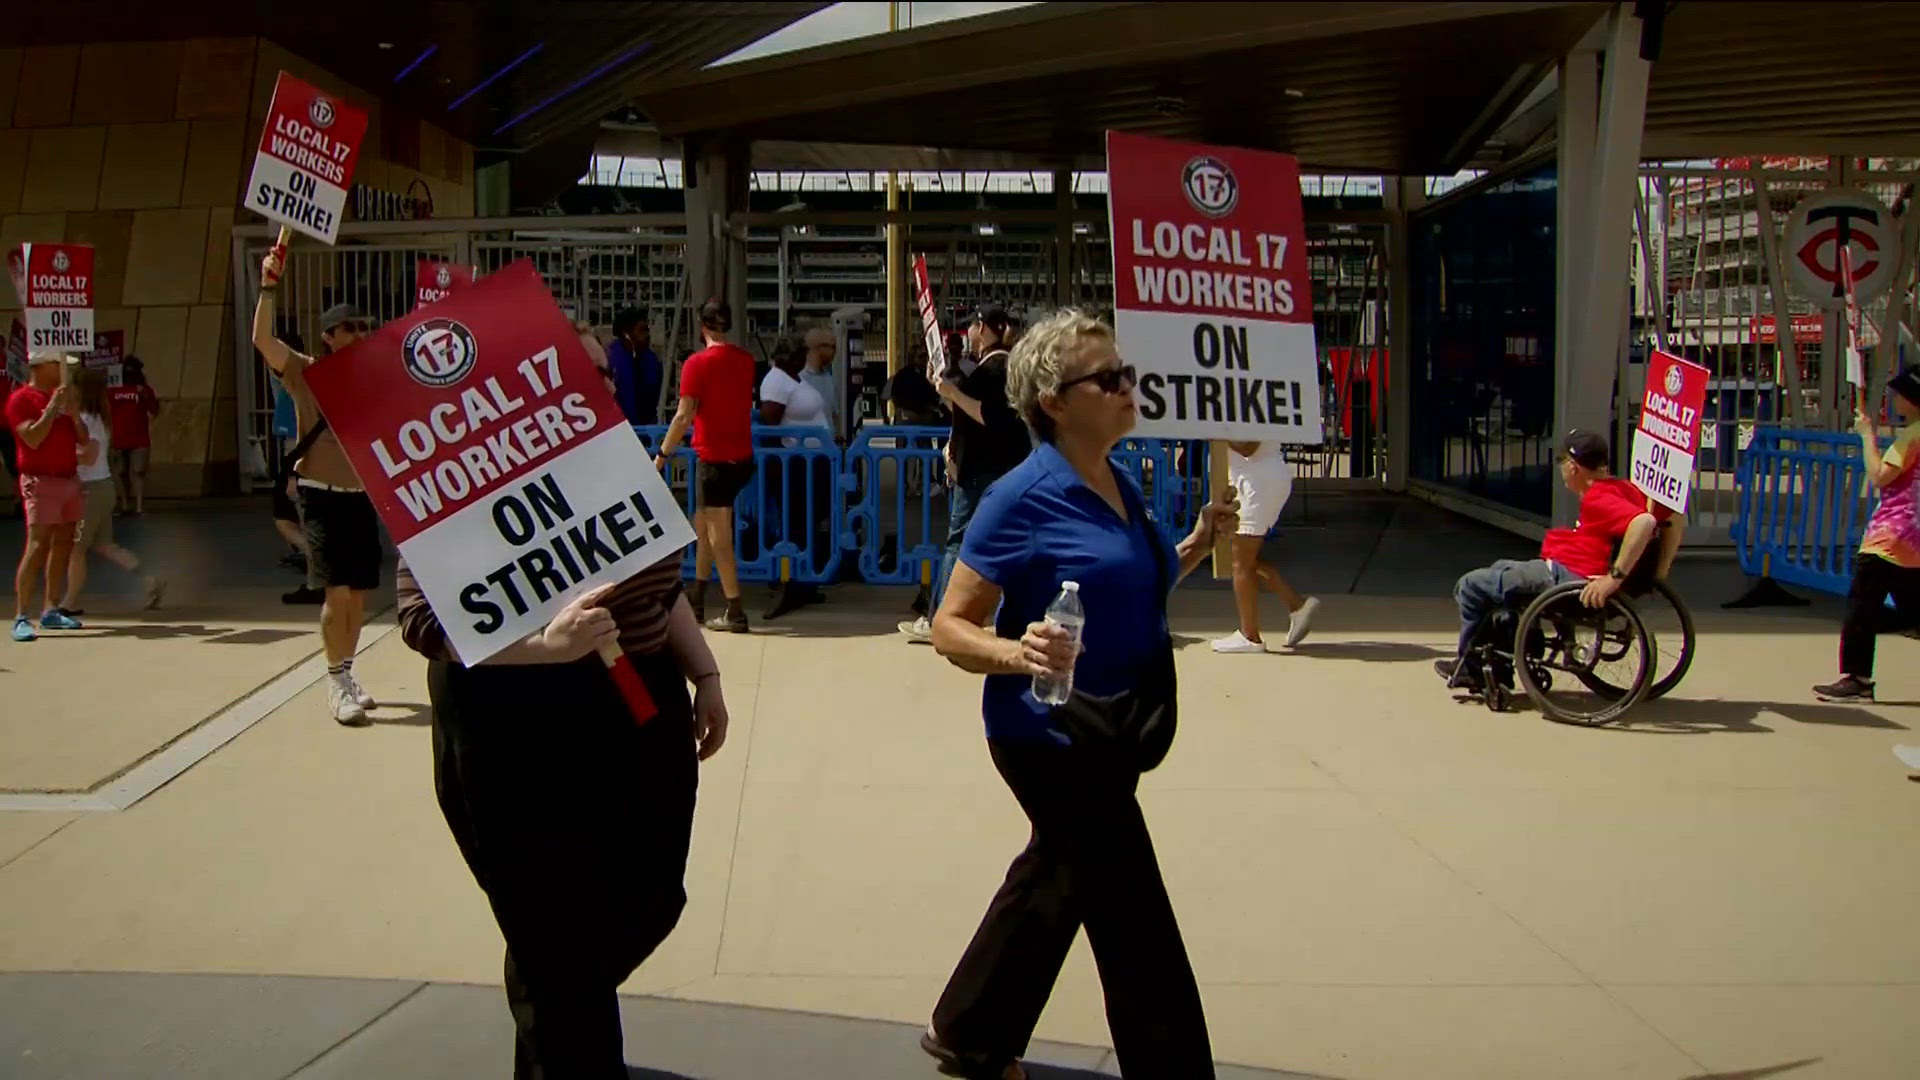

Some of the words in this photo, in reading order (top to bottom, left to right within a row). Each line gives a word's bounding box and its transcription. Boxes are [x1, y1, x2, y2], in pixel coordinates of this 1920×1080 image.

[270, 134, 345, 185] WORKERS
[276, 113, 331, 156] LOCAL
[333, 141, 351, 164] 17
[289, 170, 317, 201] ON
[1193, 173, 1225, 203] 17
[256, 183, 334, 235] STRIKE!
[1132, 218, 1251, 266] LOCAL
[1256, 233, 1289, 270] 17
[32, 275, 73, 290] LOCAL
[75, 276, 87, 290] 17
[32, 292, 88, 306] WORKERS
[1132, 265, 1294, 315] WORKERS
[33, 329, 89, 347] STRIKE!
[51, 311, 71, 328] ON
[416, 332, 456, 374] 17
[1193, 322, 1250, 371] ON
[371, 376, 526, 480] LOCAL
[517, 345, 564, 398] 17
[1138, 372, 1304, 427] STRIKE!
[1645, 389, 1680, 423] LOCAL
[1681, 406, 1696, 428] 17
[1642, 411, 1692, 450] WORKERS
[394, 393, 598, 523] WORKERS
[1651, 443, 1670, 470] ON
[1634, 460, 1683, 503] STRIKE!
[491, 472, 575, 547] ON
[458, 491, 666, 635] STRIKE!
